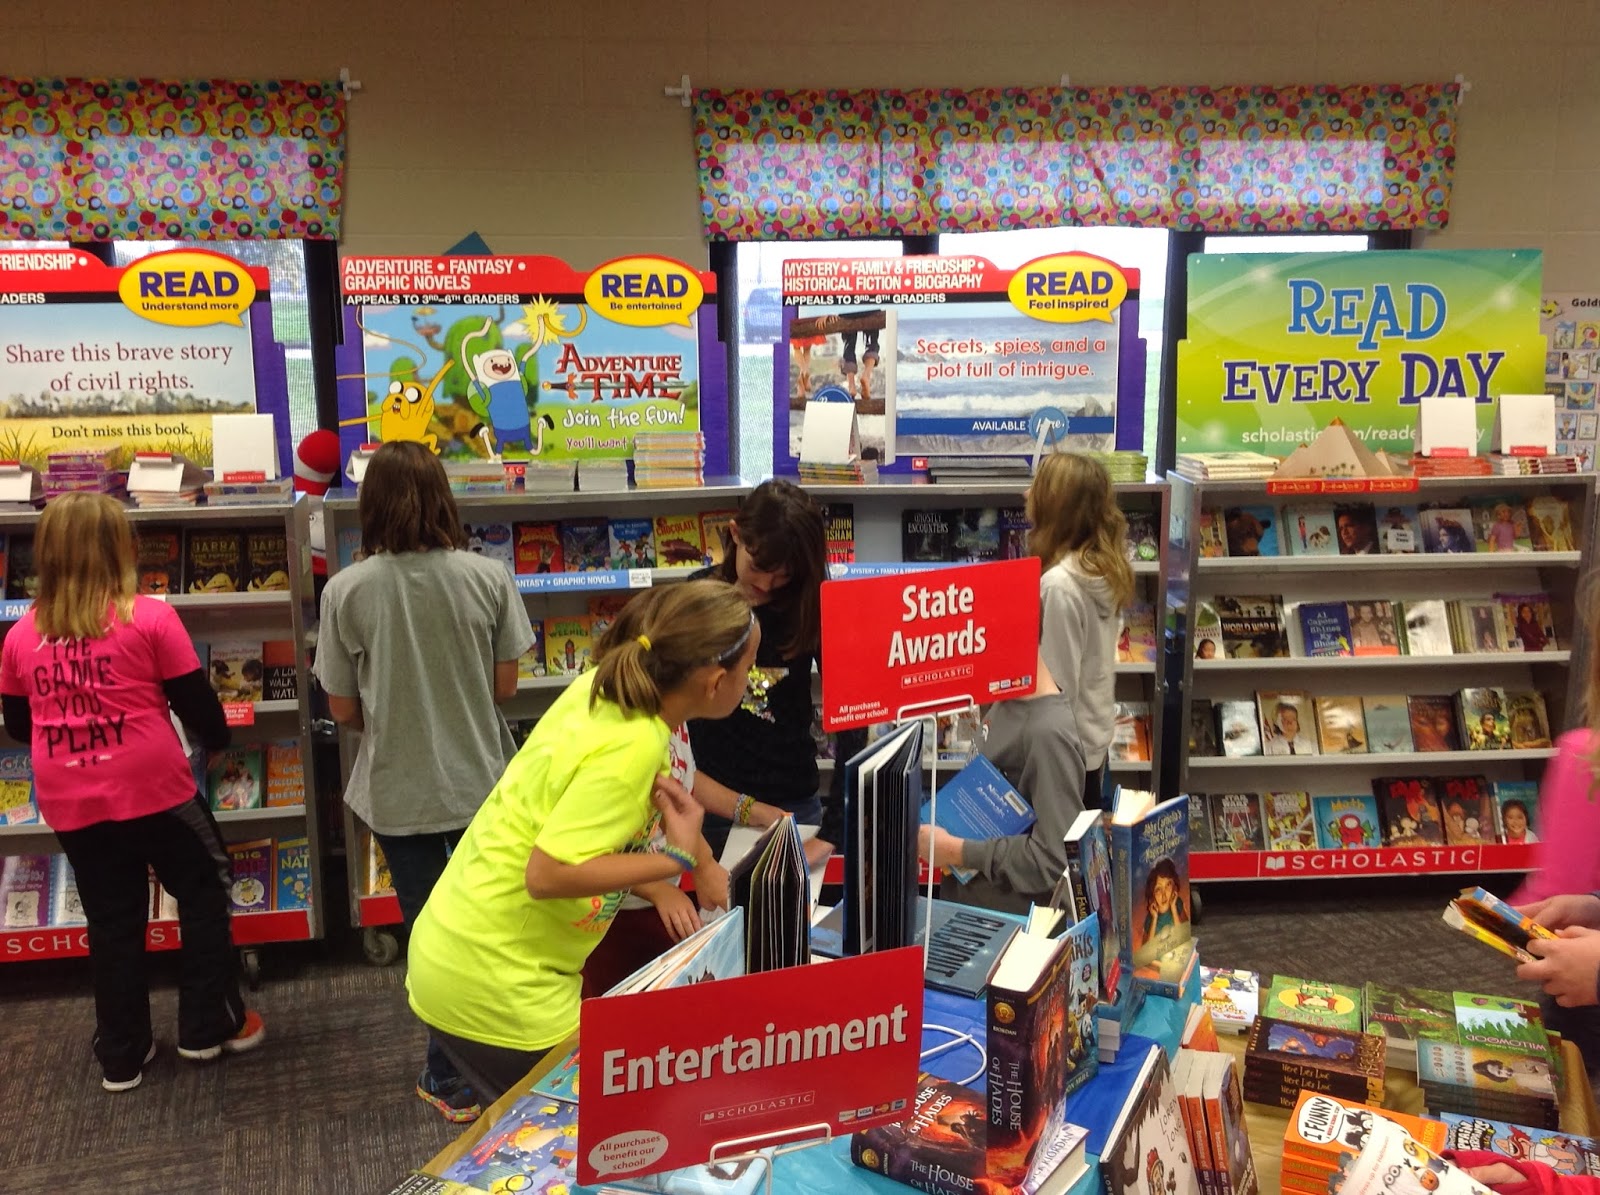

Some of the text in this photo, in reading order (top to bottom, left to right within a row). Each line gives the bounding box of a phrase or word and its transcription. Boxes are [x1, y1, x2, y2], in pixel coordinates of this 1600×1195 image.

[0, 252, 76, 271] RIENDSHIP
[345, 259, 513, 274] ADVENTURE FANTASY
[784, 260, 975, 277] MYSTERY FAMILY & FRIENDSHIP
[139, 271, 240, 298] READ
[344, 275, 471, 290] GRAPHIC NOVELS
[600, 274, 688, 299] READ
[784, 274, 983, 292] HISTORICAL FICTION BIOGRAPHY
[1025, 271, 1113, 297] READ
[0, 293, 46, 304] ADERS
[141, 302, 239, 312] Understand more
[346, 295, 400, 305] APPEALS
[403, 295, 419, 305] TO
[464, 294, 519, 304] GRADERS
[609, 302, 682, 311] Be entertained
[784, 295, 835, 305] APPEALS
[836, 295, 851, 305] TO
[893, 293, 946, 304] GRADERS
[1028, 298, 1109, 311] Feel inspired
[1572, 298, 1600, 308] Gold
[1287, 278, 1448, 350] READ
[6, 341, 234, 366] Share this brave story
[916, 336, 1107, 360] Secrets, spies, and a
[555, 342, 683, 376] ADVENTURE
[926, 361, 1096, 381] plot full of intrigue.
[1223, 351, 1506, 405] EVERY DAY
[50, 371, 195, 396] of civil rights.
[581, 372, 682, 402] TIME
[562, 408, 600, 429] Join
[606, 407, 639, 427] the
[971, 420, 1027, 432] AVAILABLE
[51, 423, 194, 440] Don't miss this book.
[565, 437, 628, 450] You'll want
[656, 520, 695, 537] CHOCOLATE
[830, 517, 852, 530] JOHN
[825, 529, 852, 541] ISHAM
[850, 567, 876, 576] MYSTERY
[515, 577, 545, 589] ANTASY
[552, 576, 585, 587] GRAPHIC
[586, 574, 617, 585] NOVELS
[6, 605, 33, 617] FAM
[902, 582, 974, 623] State
[1222, 621, 1250, 632] WORLD
[1252, 621, 1269, 632] WAR
[48, 636, 92, 661] THE
[887, 619, 987, 668] Awards
[34, 655, 115, 697] GAME
[912, 666, 972, 685] SCHOLASTIC
[55, 691, 102, 720] YOU
[838, 700, 881, 715] All purchases
[830, 707, 889, 725] benefit our school!
[41, 711, 127, 759] PLAY
[281, 855, 310, 870] NAT
[1292, 849, 1477, 869] SCHOLASTIC
[928, 910, 1006, 978] BLACKOUT
[992, 1025, 1018, 1037] RIORDAN
[602, 1003, 909, 1097] Entertainment
[1465, 1034, 1547, 1052] WILLOWOOD
[1282, 1063, 1298, 1074] Here
[1283, 1075, 1300, 1086] Here
[914, 1086, 938, 1110] OUSE
[989, 1056, 1005, 1127] OF HADES
[1007, 1061, 1024, 1131] THE HOUSE
[1281, 1085, 1297, 1096] Here
[717, 1094, 811, 1120] SCHOLASTIC
[1280, 1096, 1296, 1107] Here
[910, 1122, 921, 1135] OF
[917, 1094, 952, 1128] HADES
[1159, 1098, 1178, 1135] LOREN
[1304, 1097, 1334, 1141] I FUNNY
[599, 1134, 661, 1153] All purchases
[602, 1147, 656, 1162] benefit our
[611, 1157, 647, 1171] school!
[910, 1159, 975, 1192] THE HOUSE
[910, 1178, 922, 1188] OF
